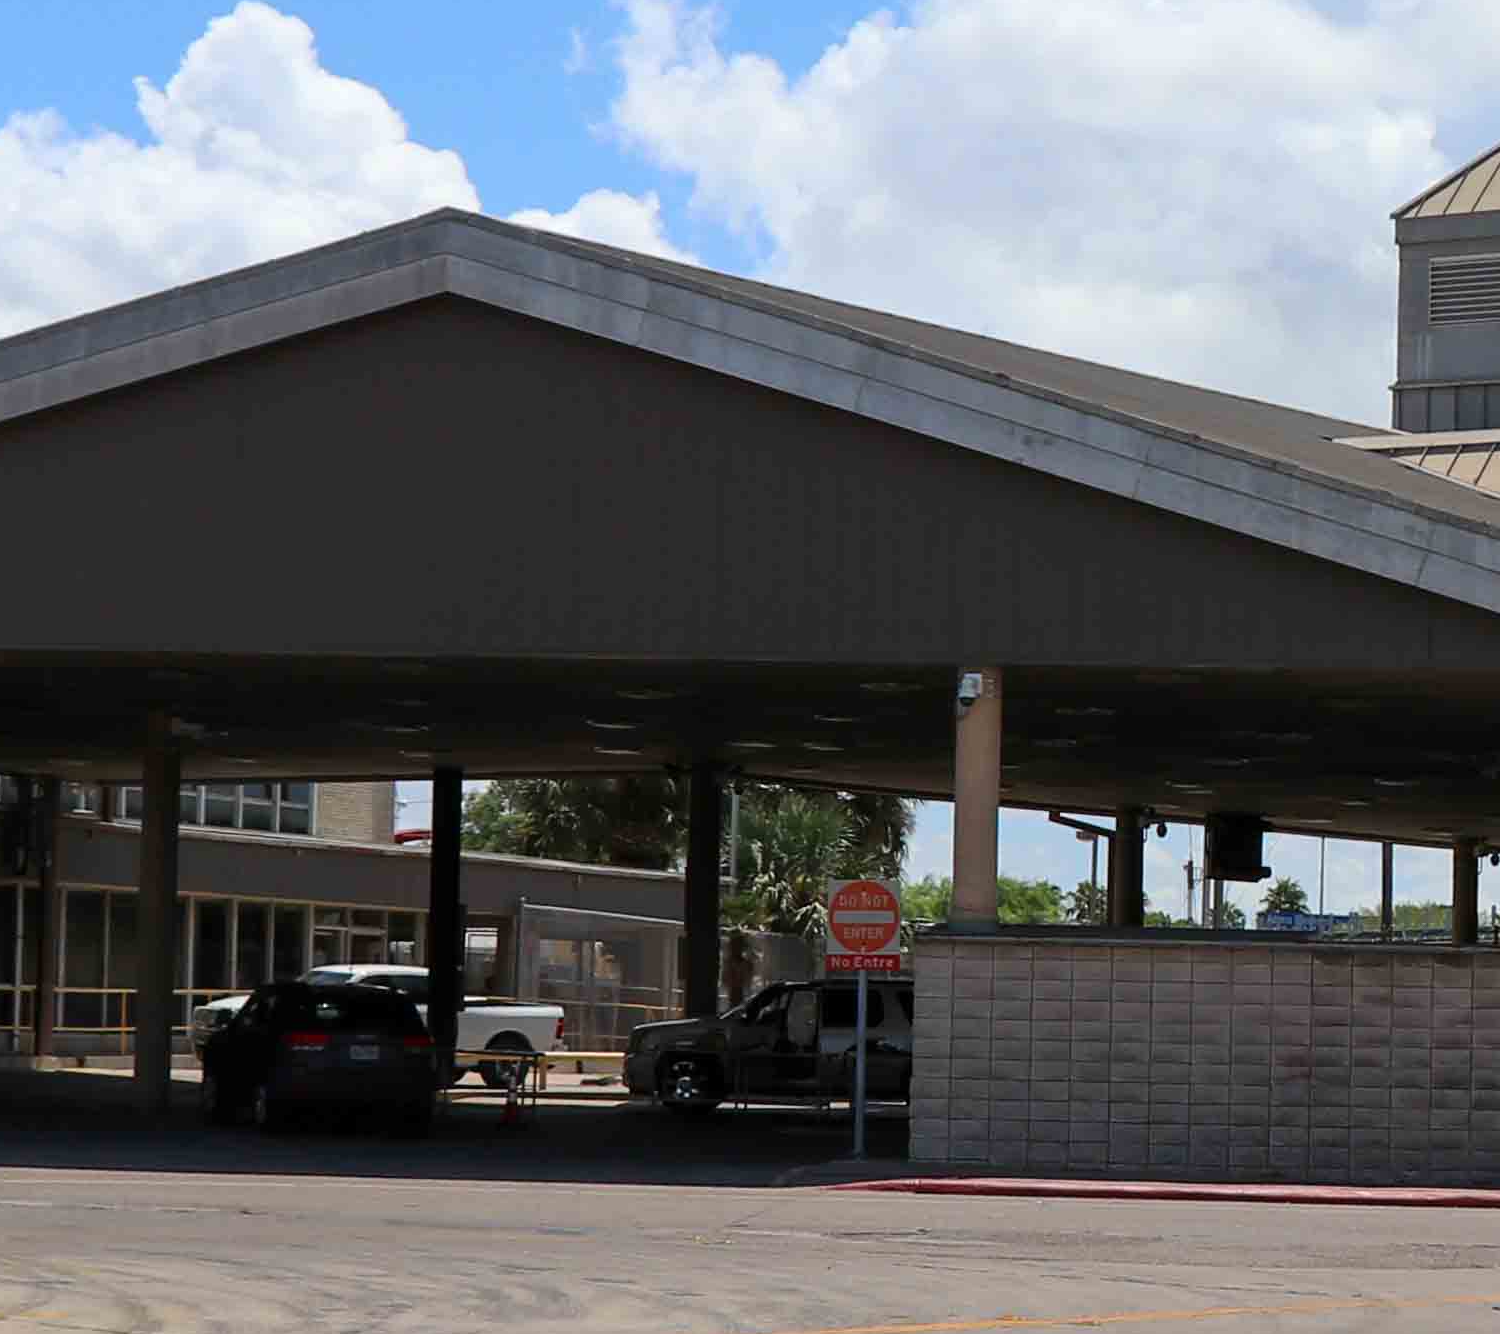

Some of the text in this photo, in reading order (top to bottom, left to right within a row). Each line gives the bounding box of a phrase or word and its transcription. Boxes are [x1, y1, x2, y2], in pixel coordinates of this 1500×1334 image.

[838, 894, 890, 908] DO NOT
[843, 926, 885, 940] ENTER
[831, 956, 894, 969] No Entre
